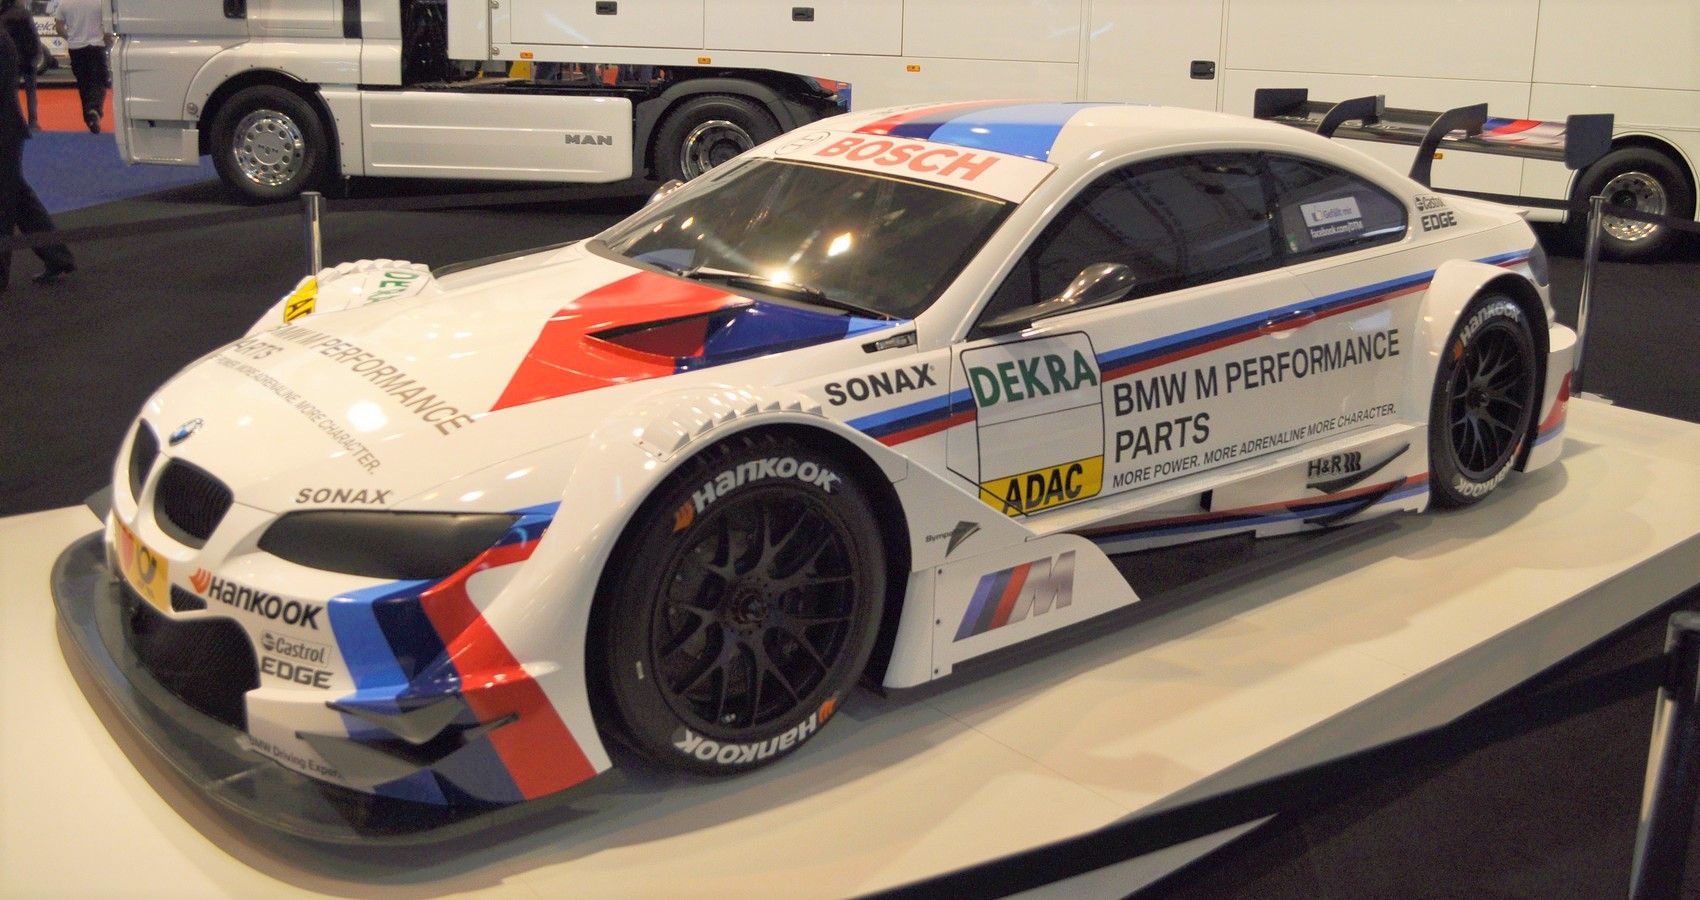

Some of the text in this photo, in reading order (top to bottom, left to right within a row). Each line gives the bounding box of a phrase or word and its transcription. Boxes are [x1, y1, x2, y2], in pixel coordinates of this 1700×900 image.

[565, 134, 613, 146] MAN
[814, 137, 1000, 181] BOSCH
[1421, 211, 1457, 232] EDGE
[310, 338, 475, 436] PERFORMANCE
[824, 363, 936, 406] SONAX
[969, 350, 1098, 408] DEKRA
[1113, 329, 1400, 417] BMW M PERFORMANCE
[319, 419, 381, 475] CHARACTER.
[1112, 469, 1150, 488] MORE
[1154, 459, 1200, 479] POWER.
[1204, 446, 1238, 465] MORE
[1307, 418, 1336, 437] MORE
[1337, 403, 1396, 428] CHARACTER.
[1115, 412, 1210, 463] PARTS
[1308, 453, 1342, 477] H&R
[296, 489, 391, 505] SONAX
[1002, 463, 1083, 515] ADAC
[262, 656, 333, 689] EDGE
[276, 637, 325, 664] Castrol
